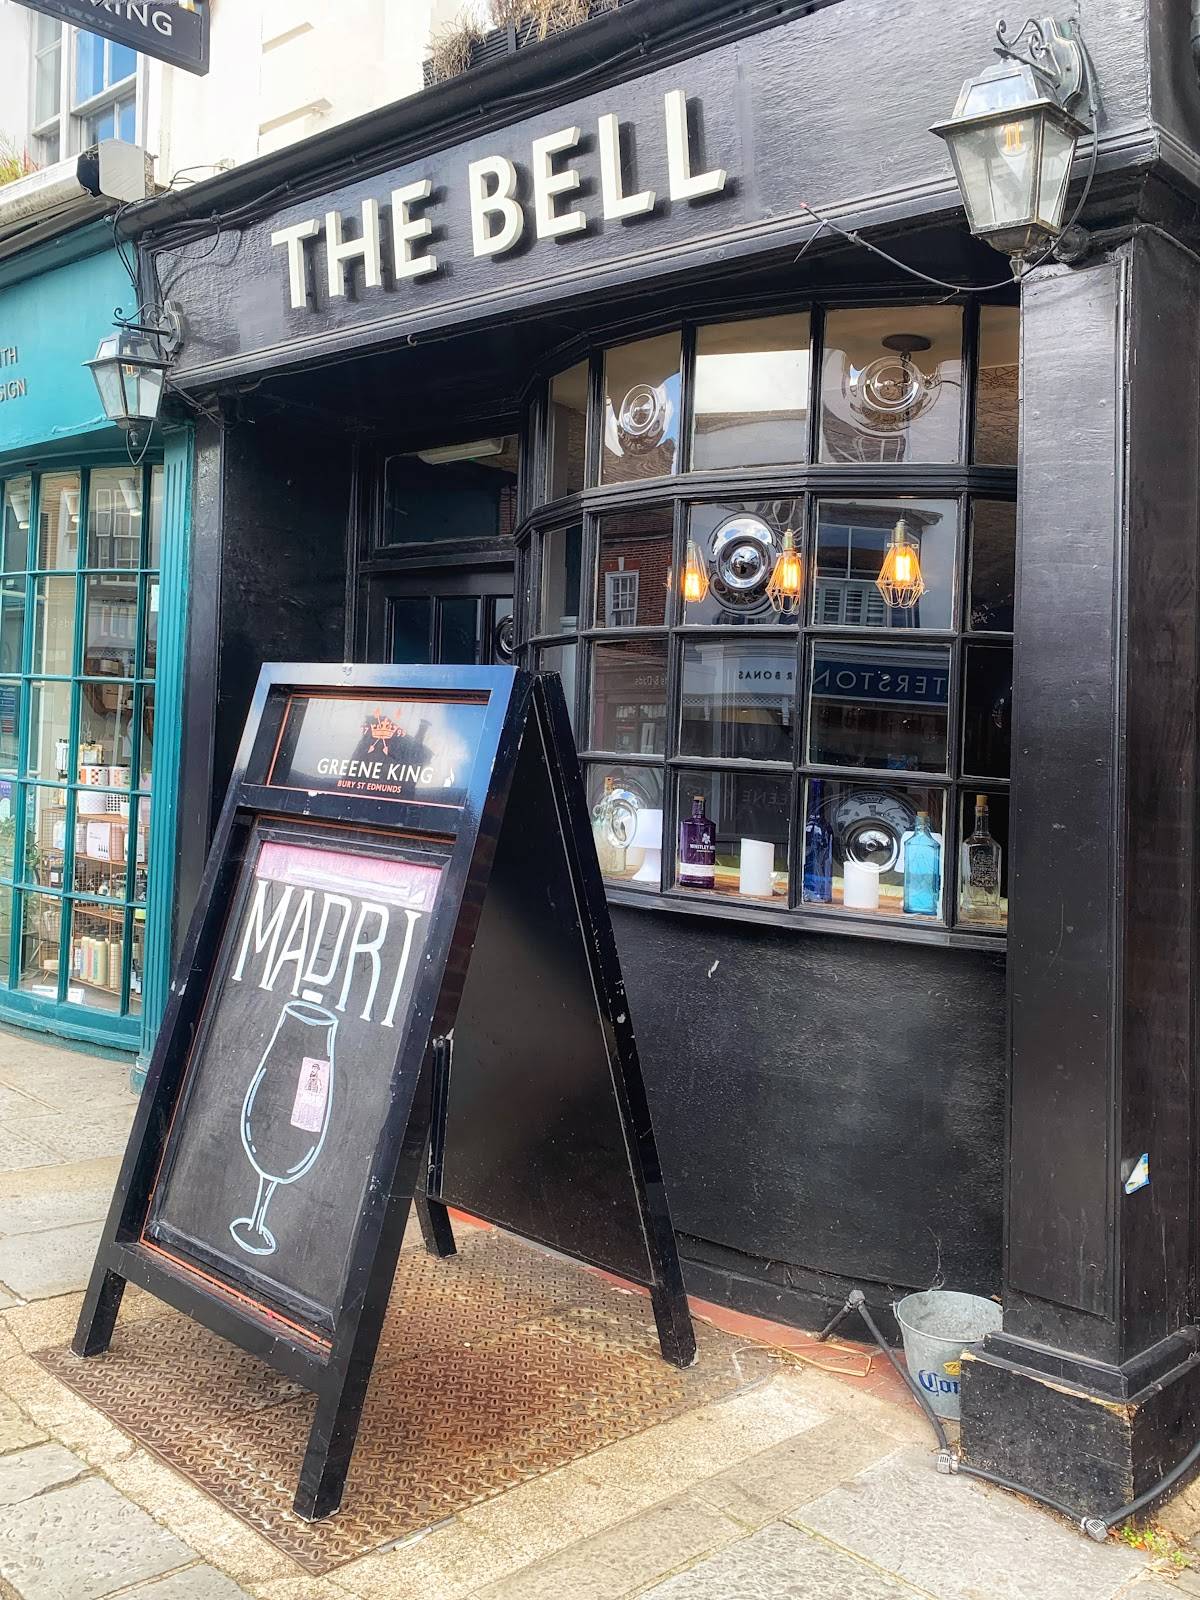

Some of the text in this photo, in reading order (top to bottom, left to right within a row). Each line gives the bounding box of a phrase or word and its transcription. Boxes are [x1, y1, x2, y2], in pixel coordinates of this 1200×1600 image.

[271, 89, 727, 308] THE BELL
[317, 758, 434, 783] GREENE KING
[337, 779, 402, 793] BURY ST EDMUNDS
[232, 880, 422, 1027] MADRI
